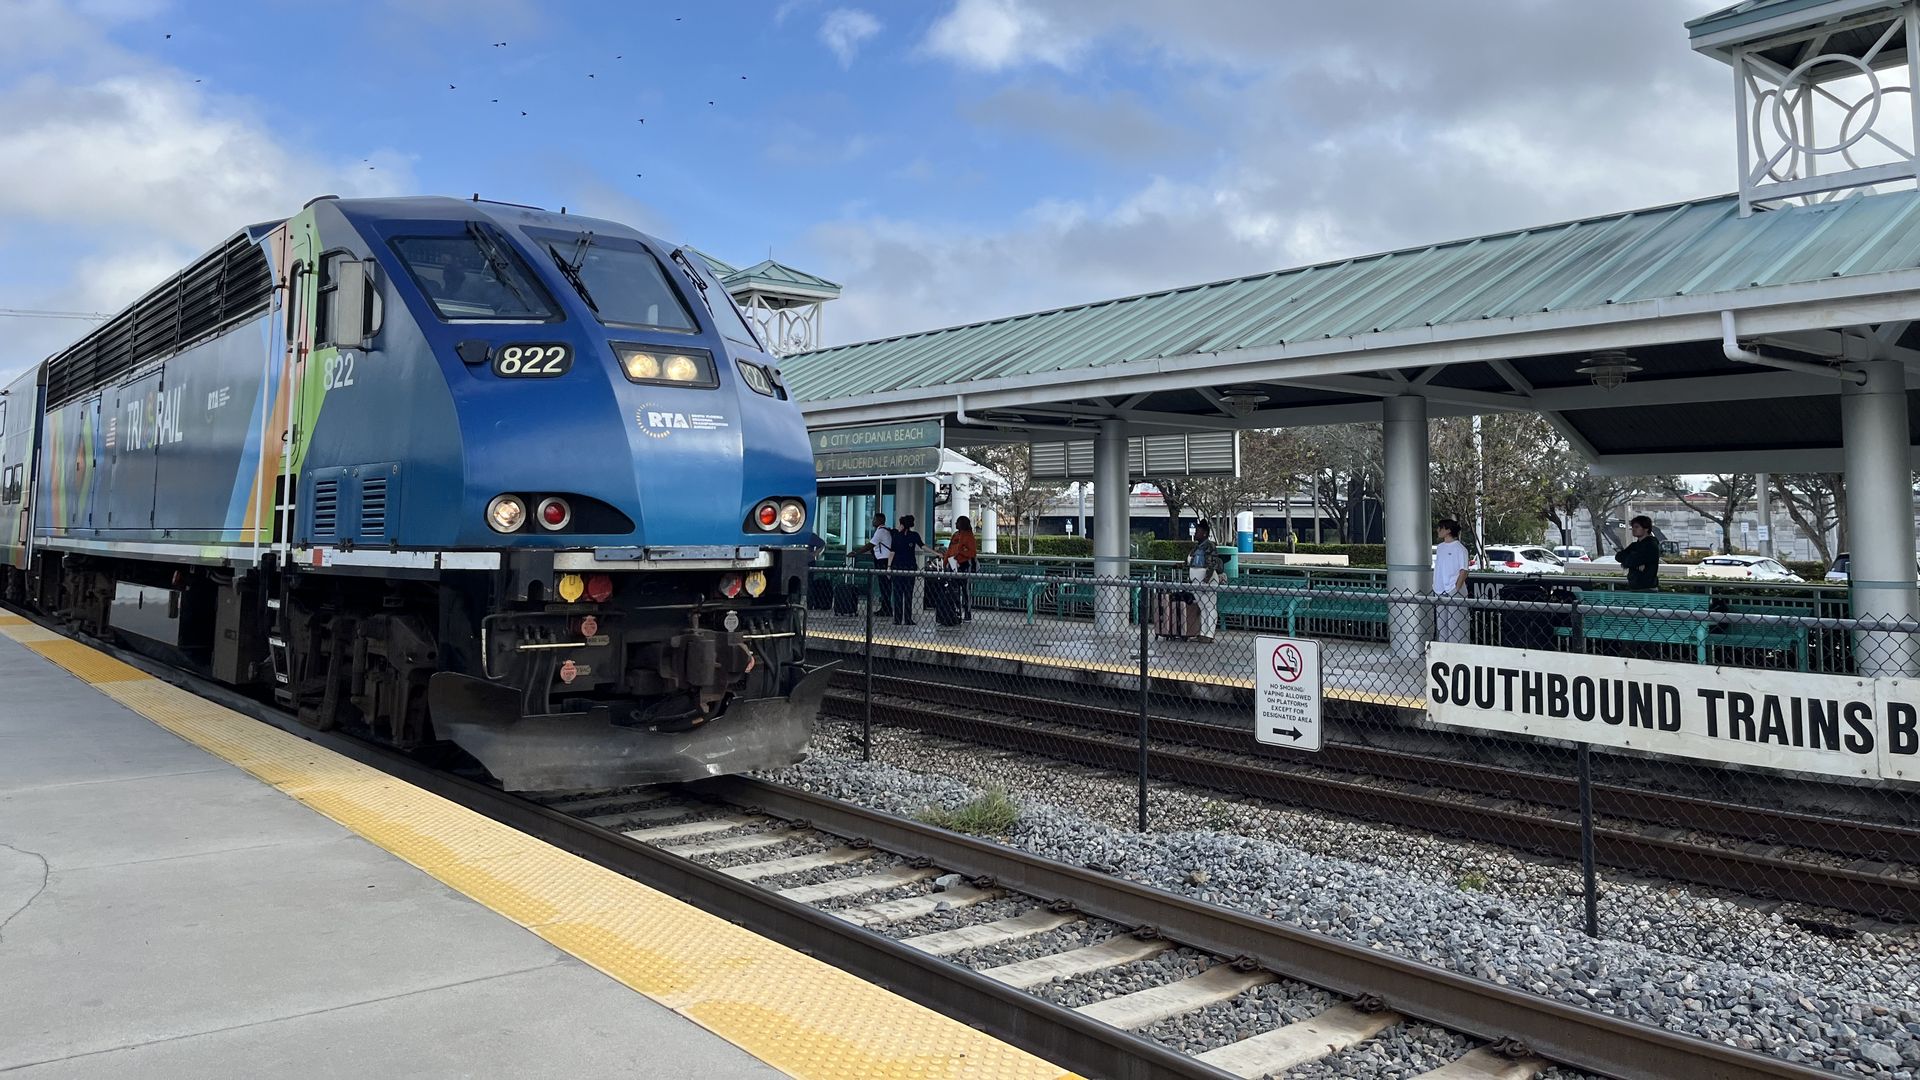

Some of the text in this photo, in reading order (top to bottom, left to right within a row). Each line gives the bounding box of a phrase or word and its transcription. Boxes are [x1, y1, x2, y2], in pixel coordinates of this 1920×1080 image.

[500, 346, 566, 374] 822
[323, 352, 354, 391] 822
[126, 387, 183, 452] TRI RAIL
[647, 411, 690, 429] RTA
[830, 428, 924, 447] CITY OF DANIA BEACH
[838, 456, 888, 470] LAUDERDALE
[890, 454, 926, 466] AIRPORT
[1276, 699, 1308, 708] PLATFORMS
[1286, 692, 1312, 701] ALLOWED
[1262, 711, 1296, 721] DESIGNATED
[1430, 661, 1682, 732] SOUTHBOUND
[1697, 688, 1875, 755] TRAINS
